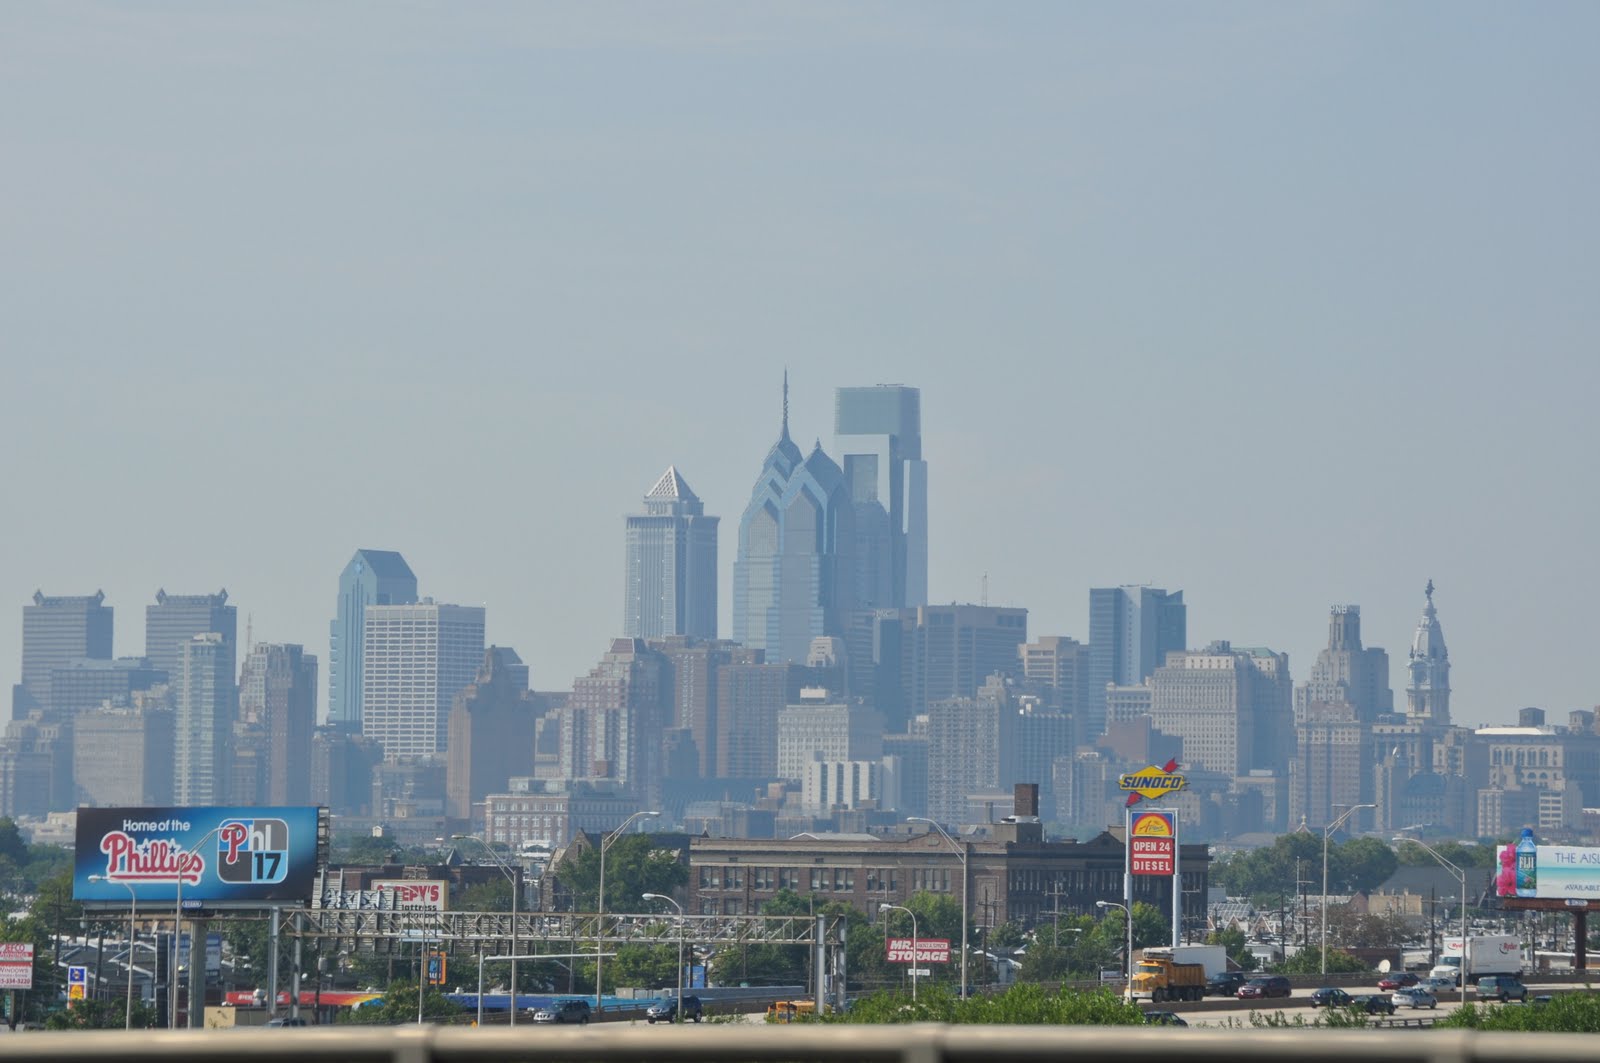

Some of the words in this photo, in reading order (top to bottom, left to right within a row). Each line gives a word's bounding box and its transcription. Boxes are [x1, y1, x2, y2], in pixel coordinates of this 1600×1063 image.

[1330, 604, 1348, 614] PNB
[1121, 776, 1181, 789] SUNOCO
[122, 819, 157, 832] Home
[158, 819, 170, 832] of
[171, 819, 191, 832] the
[1133, 841, 1157, 852] OPEN
[1159, 842, 1171, 852] 24
[102, 832, 204, 875] Phillies
[1555, 852, 1576, 864] THE
[254, 852, 282, 880] 17
[1133, 861, 1171, 871] DIESEL
[1519, 856, 1534, 870] FIJI
[1564, 884, 1600, 892] AVAILABLE
[889, 940, 914, 950] MR.
[1503, 942, 1517, 951] Ryder
[887, 951, 949, 961] STORAGE
